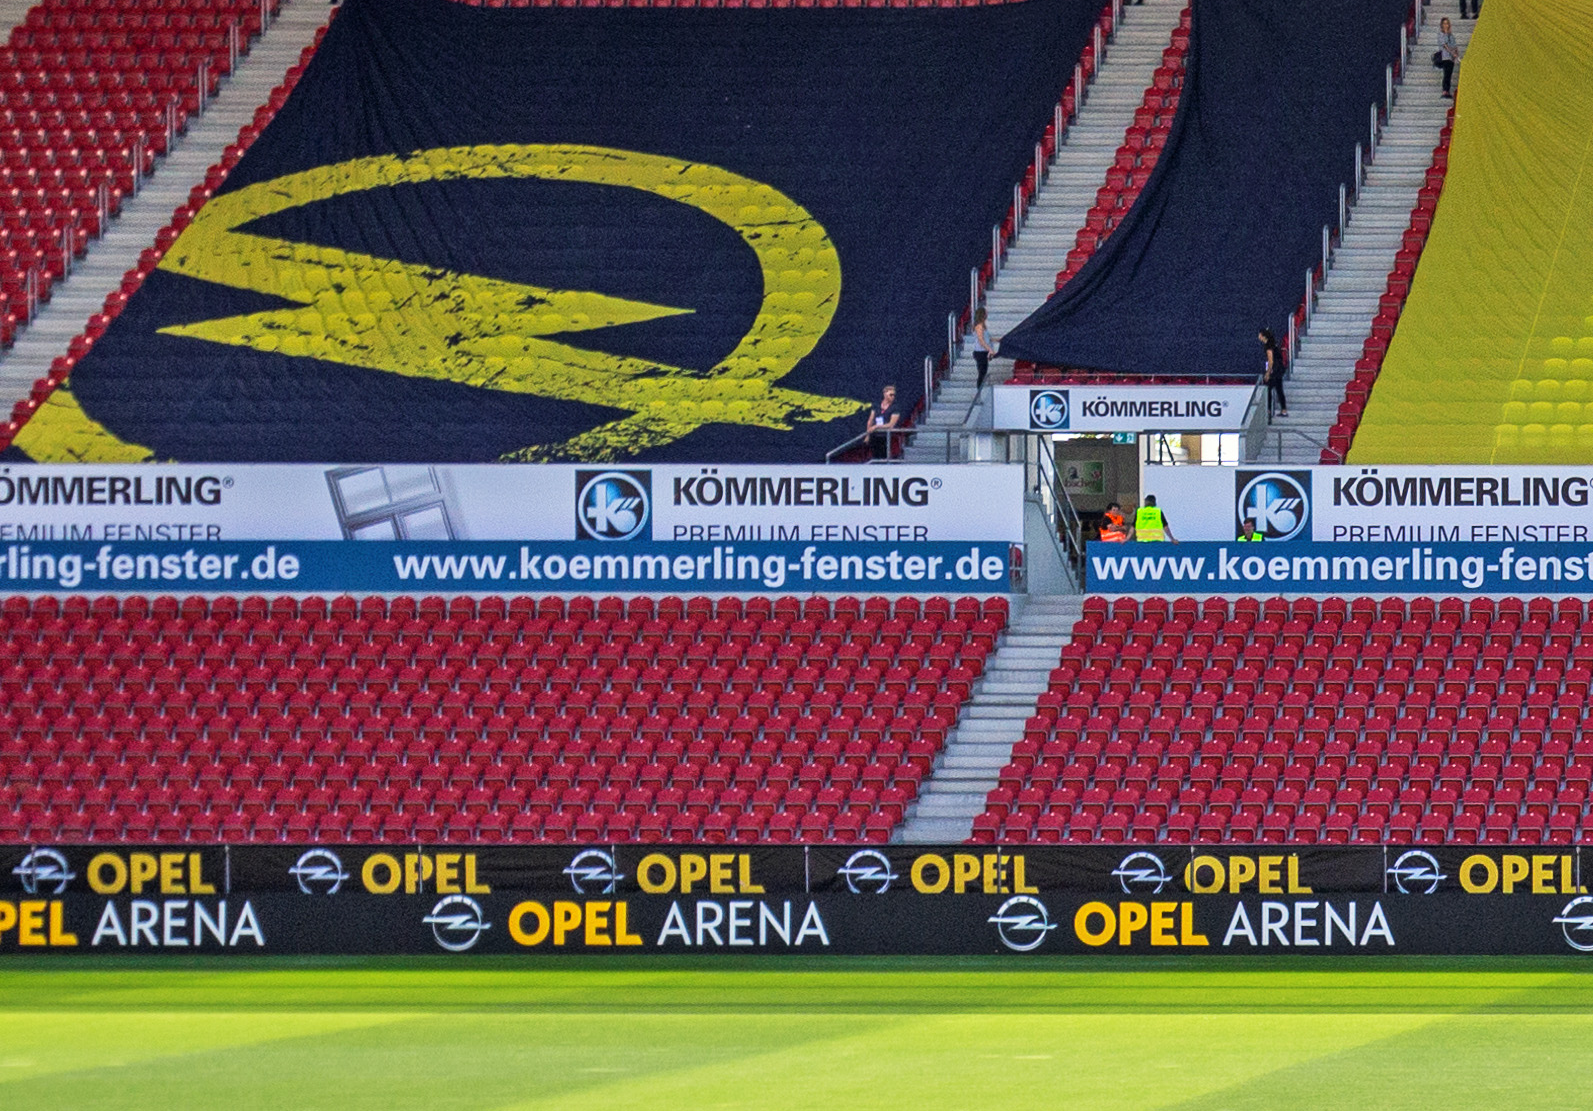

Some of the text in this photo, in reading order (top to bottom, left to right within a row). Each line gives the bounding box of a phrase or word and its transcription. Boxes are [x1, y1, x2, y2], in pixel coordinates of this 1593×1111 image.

[394, 547, 1003, 587] www.koemmerling-fenster.de
[87, 852, 215, 894] OPEL
[361, 852, 491, 894] OPEL
[636, 853, 765, 894] OPEL
[910, 853, 1039, 894] OPEL
[1183, 855, 1313, 894] OPEL
[1459, 853, 1588, 894] OPEL
[92, 901, 264, 946] ARENA
[509, 901, 829, 946] OPEL ARENA
[1074, 901, 1395, 946] OPEL ARENA
